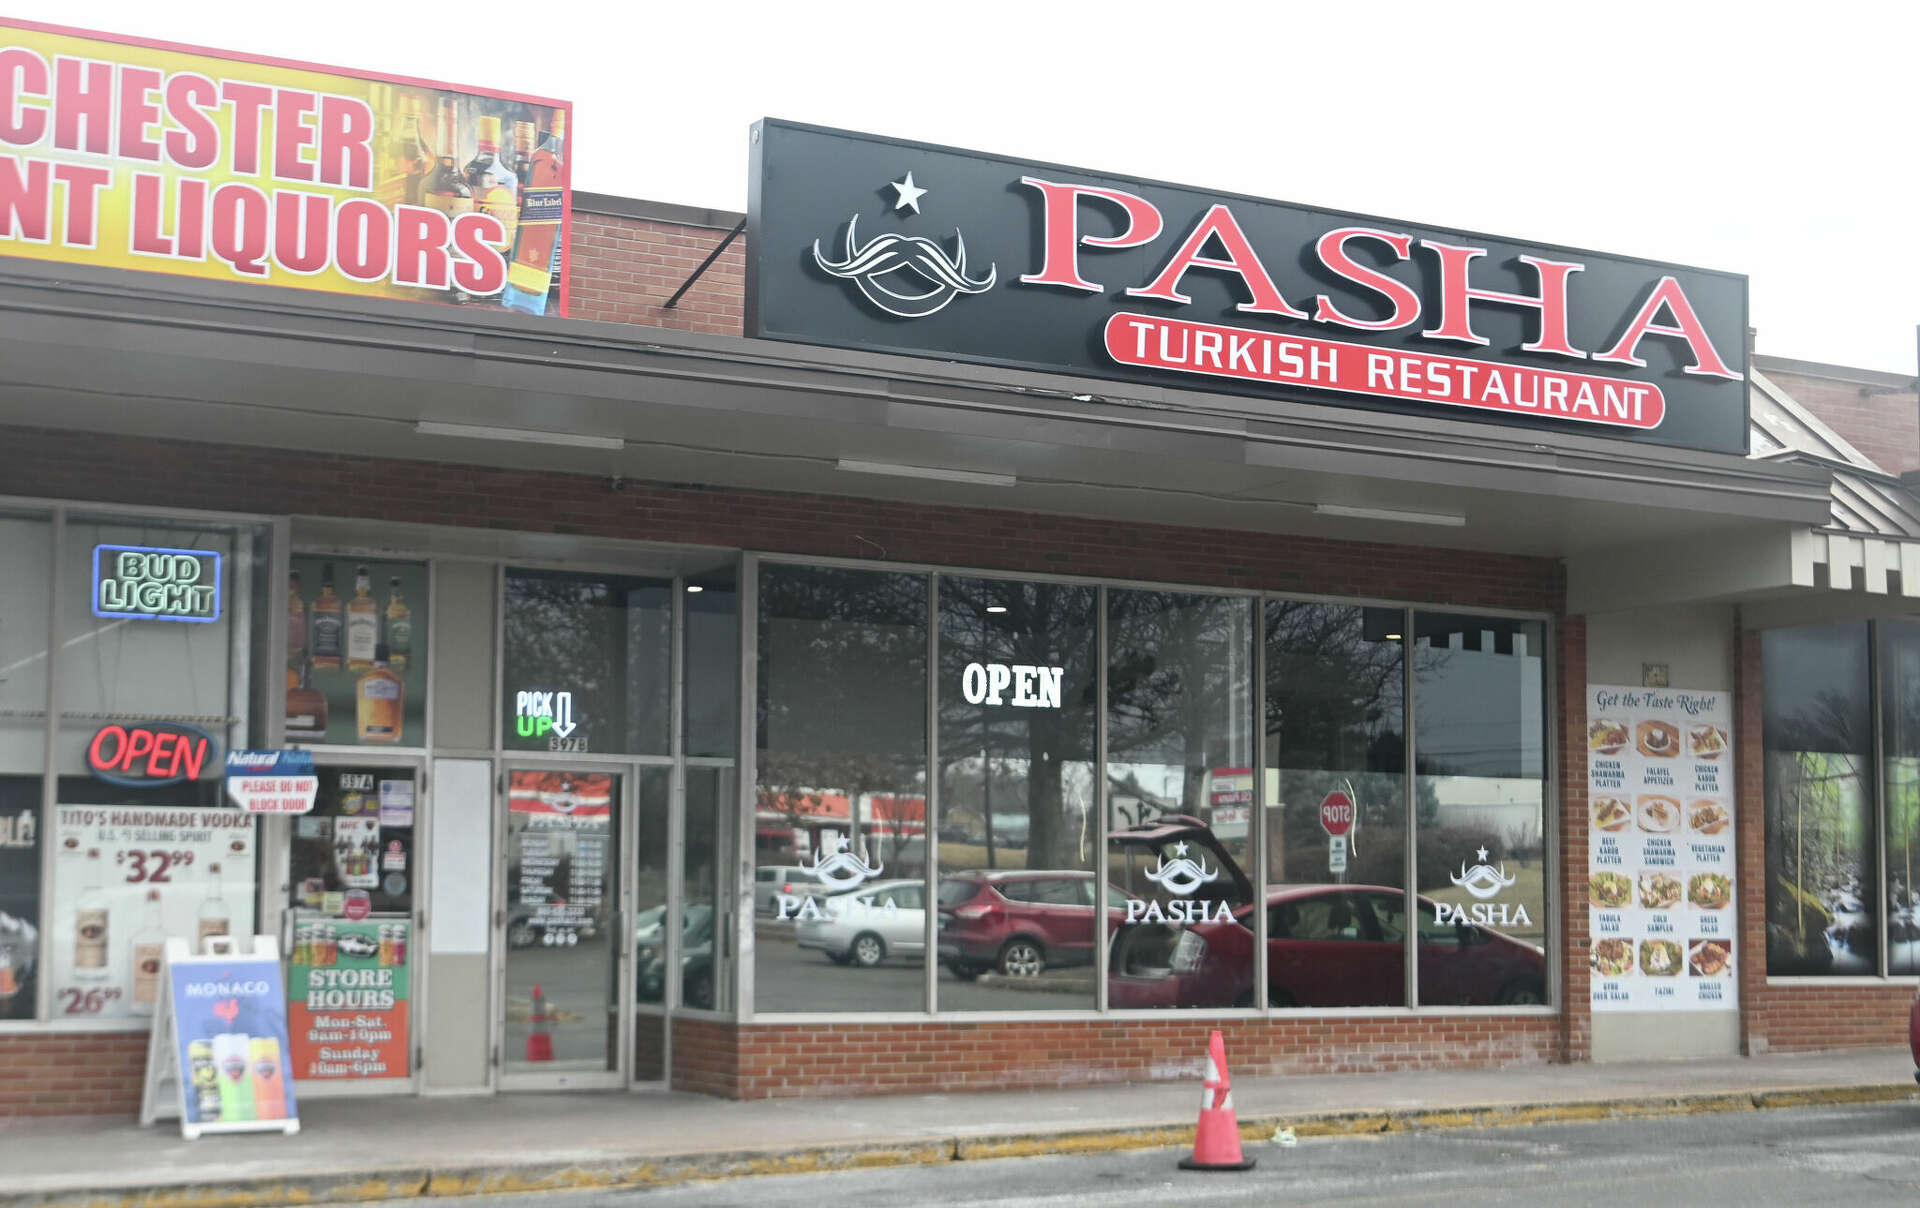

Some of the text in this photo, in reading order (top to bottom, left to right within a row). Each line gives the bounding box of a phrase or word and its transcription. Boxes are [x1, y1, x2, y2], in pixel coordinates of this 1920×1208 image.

[0, 47, 373, 192] CHESTER
[129, 170, 509, 297] LIQUORS
[1020, 175, 1744, 381] PASHA
[1128, 320, 1649, 421] TURKISH RESTAURANT
[117, 551, 201, 584] BUD
[100, 579, 215, 614] LIGHT
[963, 662, 1064, 708] OPEN
[516, 690, 553, 717] PICK
[1596, 689, 1716, 716] Get the Taste Right!
[517, 715, 553, 737] UP
[88, 724, 207, 781] OPEN
[227, 750, 280, 766] Natural
[242, 780, 313, 793] PLEASE DO NOT
[249, 798, 307, 811] BLOCK DOOR
[60, 810, 253, 829] TITO'S HANDMADE VODKA
[135, 830, 176, 842] SELLING
[179, 831, 212, 842] SPIRIT
[776, 895, 898, 921] PAA
[1125, 900, 1238, 924] PASHA
[1433, 903, 1533, 927] PASHA
[185, 980, 270, 997] MONACO
[309, 968, 393, 987] STORE
[306, 989, 395, 1009] HOURS
[319, 1046, 380, 1062] Sunday
